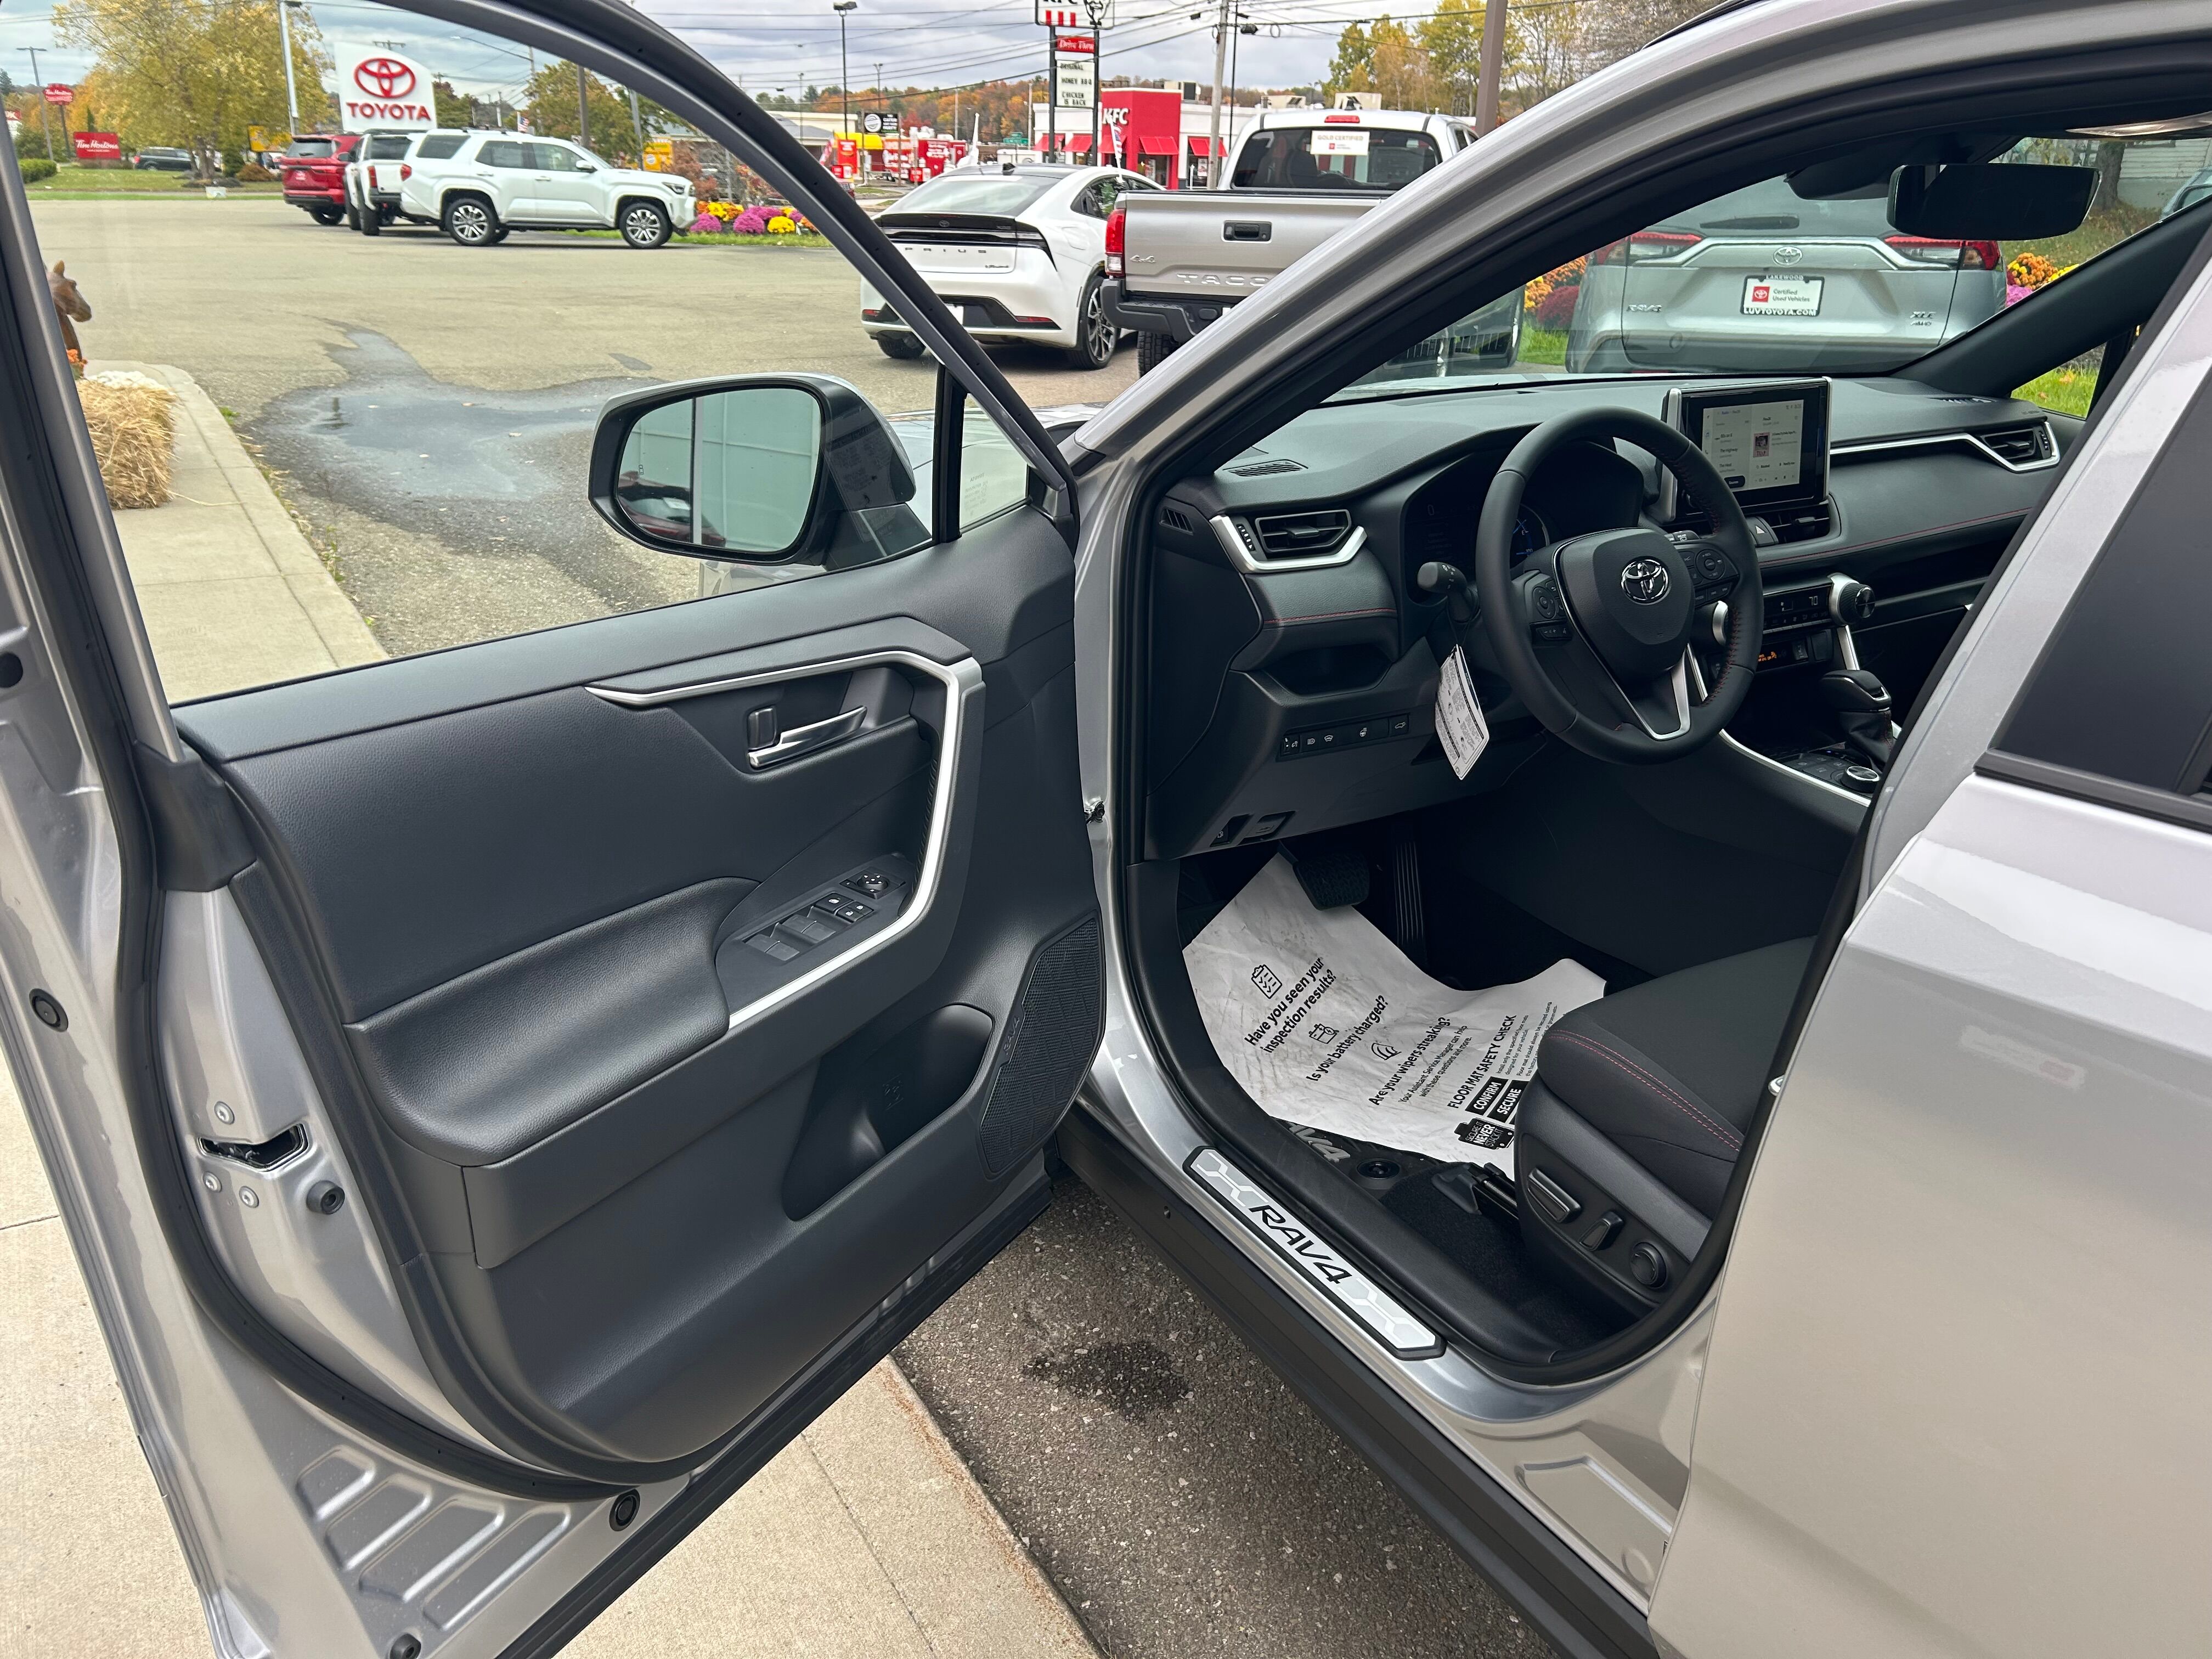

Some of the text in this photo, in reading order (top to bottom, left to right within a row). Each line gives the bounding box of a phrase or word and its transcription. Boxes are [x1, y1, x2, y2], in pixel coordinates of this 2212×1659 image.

[346, 102, 431, 121] TOYOTA
[1102, 108, 1129, 125] KFC
[76, 139, 90, 149] Tim
[1177, 273, 1270, 286] TACO
[1626, 304, 1662, 313] RAV4
[1743, 307, 1817, 317] LUVTOYOTA.COM
[1244, 957, 1324, 1046] Have you seen your
[1260, 969, 1336, 1053] inspection results?
[1306, 995, 1388, 1081] Is your battery charged?
[1368, 1017, 1450, 1105] Are your wipers streaking?
[1407, 1074, 1428, 1093] Assistant
[1423, 1057, 1440, 1074] Service
[1435, 1042, 1454, 1062] Manager
[1447, 1015, 1516, 1108] FLOOR MAT SAFETY CHECK
[1419, 1087, 1431, 1097] with
[1426, 1075, 1441, 1087] these
[1437, 1056, 1457, 1074] questions
[1473, 1081, 1502, 1109] CONFIRM
[1497, 1088, 1521, 1114] SECURE
[1465, 1125, 1481, 1141] SECURE
[1472, 1124, 1495, 1144] NEVER
[1484, 1132, 1500, 1147] STACK
[1248, 1204, 1353, 1284] RAV4
